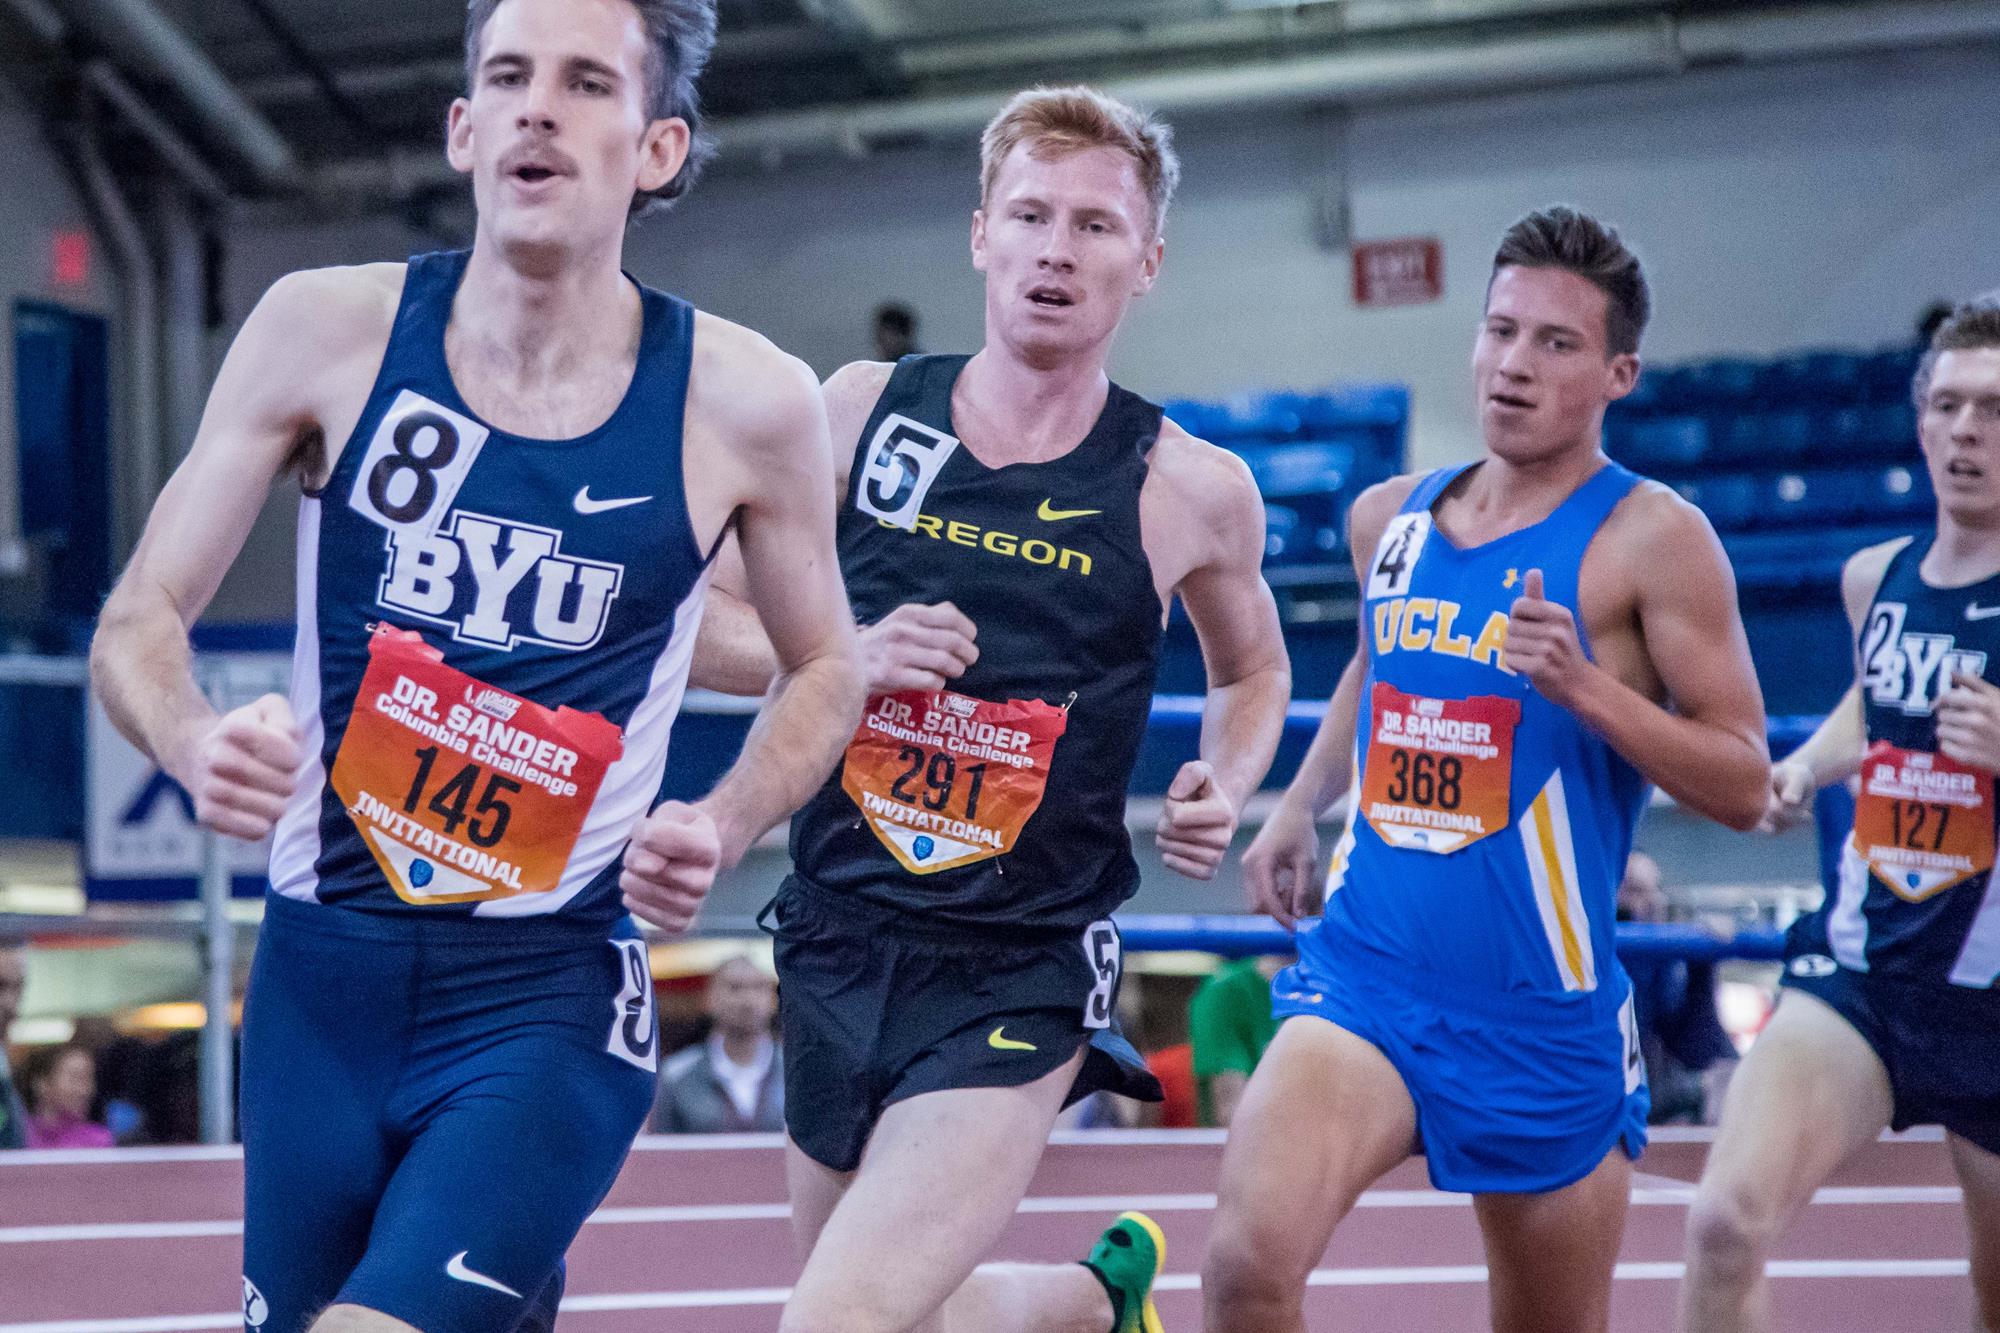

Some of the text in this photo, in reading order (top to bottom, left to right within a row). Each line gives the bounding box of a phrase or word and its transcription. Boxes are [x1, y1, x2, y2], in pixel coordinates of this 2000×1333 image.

[368, 410, 459, 523] 8
[867, 422, 940, 513] 5
[378, 510, 624, 651] BYU
[1376, 519, 1416, 588] 4
[1373, 597, 1517, 676] UCLA
[1866, 611, 1892, 676] 2
[376, 693, 577, 796] Columbia Challenge
[391, 675, 578, 776] DR. SANDER
[867, 714, 1034, 769] Columbia Challenge
[879, 697, 915, 727] DR.
[923, 711, 1031, 752] SANDER
[1382, 710, 1492, 743] DR. SANDER
[1425, 737, 1498, 760] Challenge
[403, 746, 522, 847] 145
[891, 745, 985, 820] 291
[1388, 750, 1463, 810] 368
[1900, 765, 1976, 791] SANDER
[355, 791, 523, 889] INVITATIONAL
[862, 791, 1003, 848] INVITATIONAL
[1369, 802, 1485, 833] INVITATIONAL
[1893, 802, 1949, 849] 127
[1092, 929, 1115, 1020] 5
